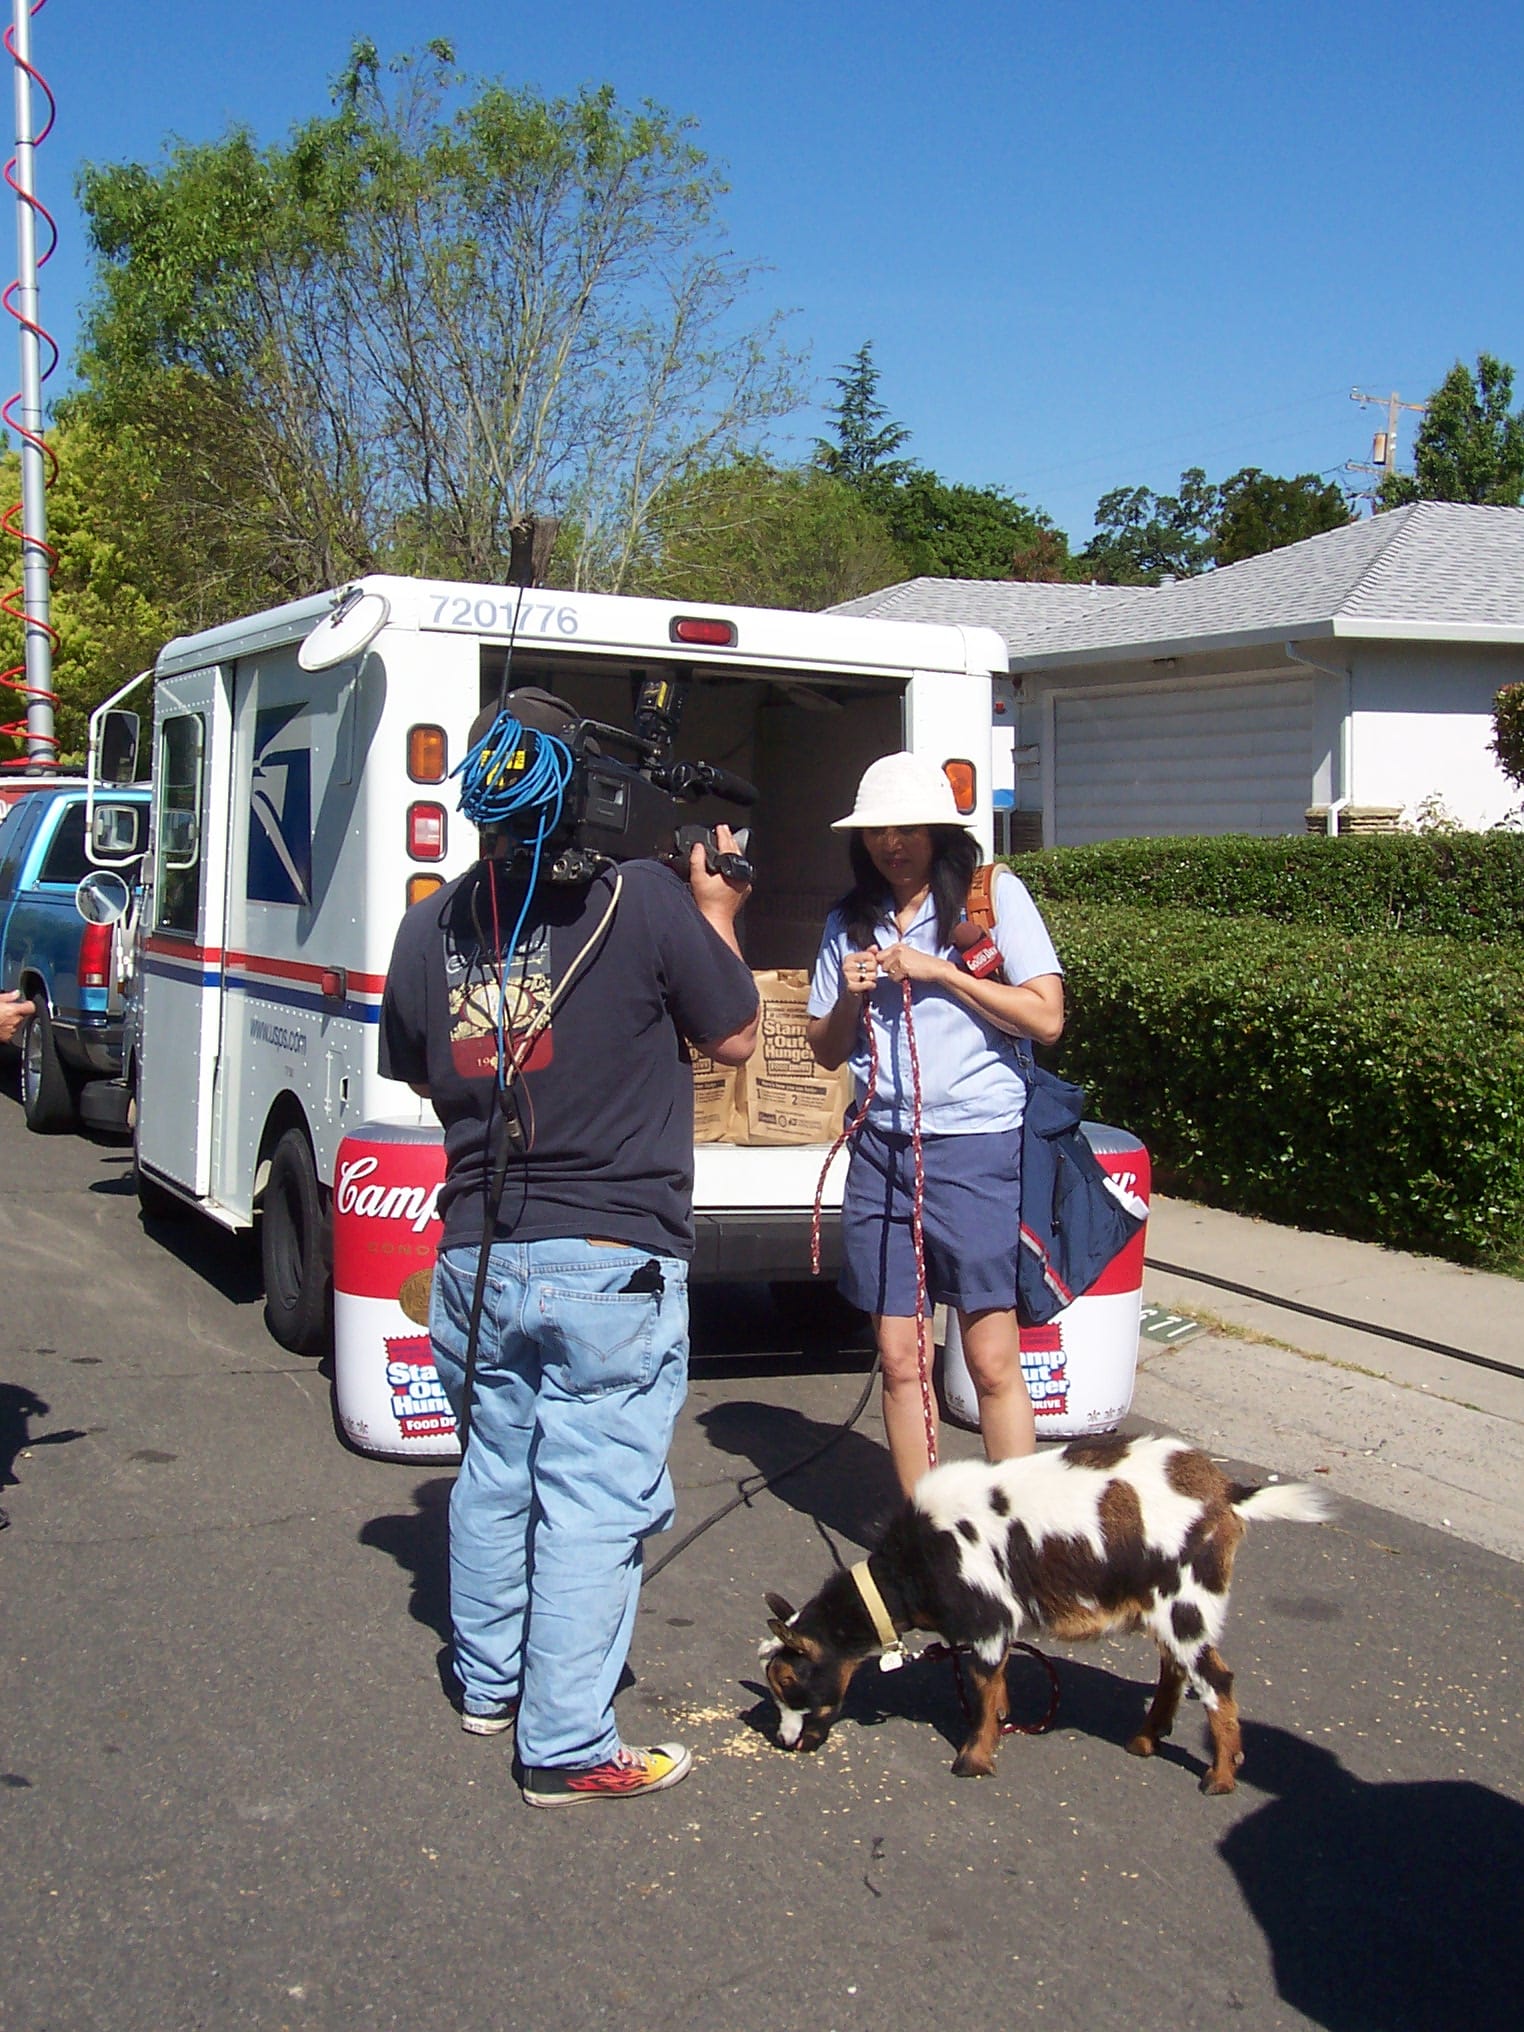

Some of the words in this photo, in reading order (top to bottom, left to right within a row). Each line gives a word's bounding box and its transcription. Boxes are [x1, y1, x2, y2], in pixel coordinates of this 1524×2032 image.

[429, 594, 578, 635] 7201776
[250, 1019, 307, 1057] www.usps.com
[775, 1035, 805, 1049] Out
[791, 1094, 798, 1105] 2
[406, 1418, 440, 1431] FOOD
